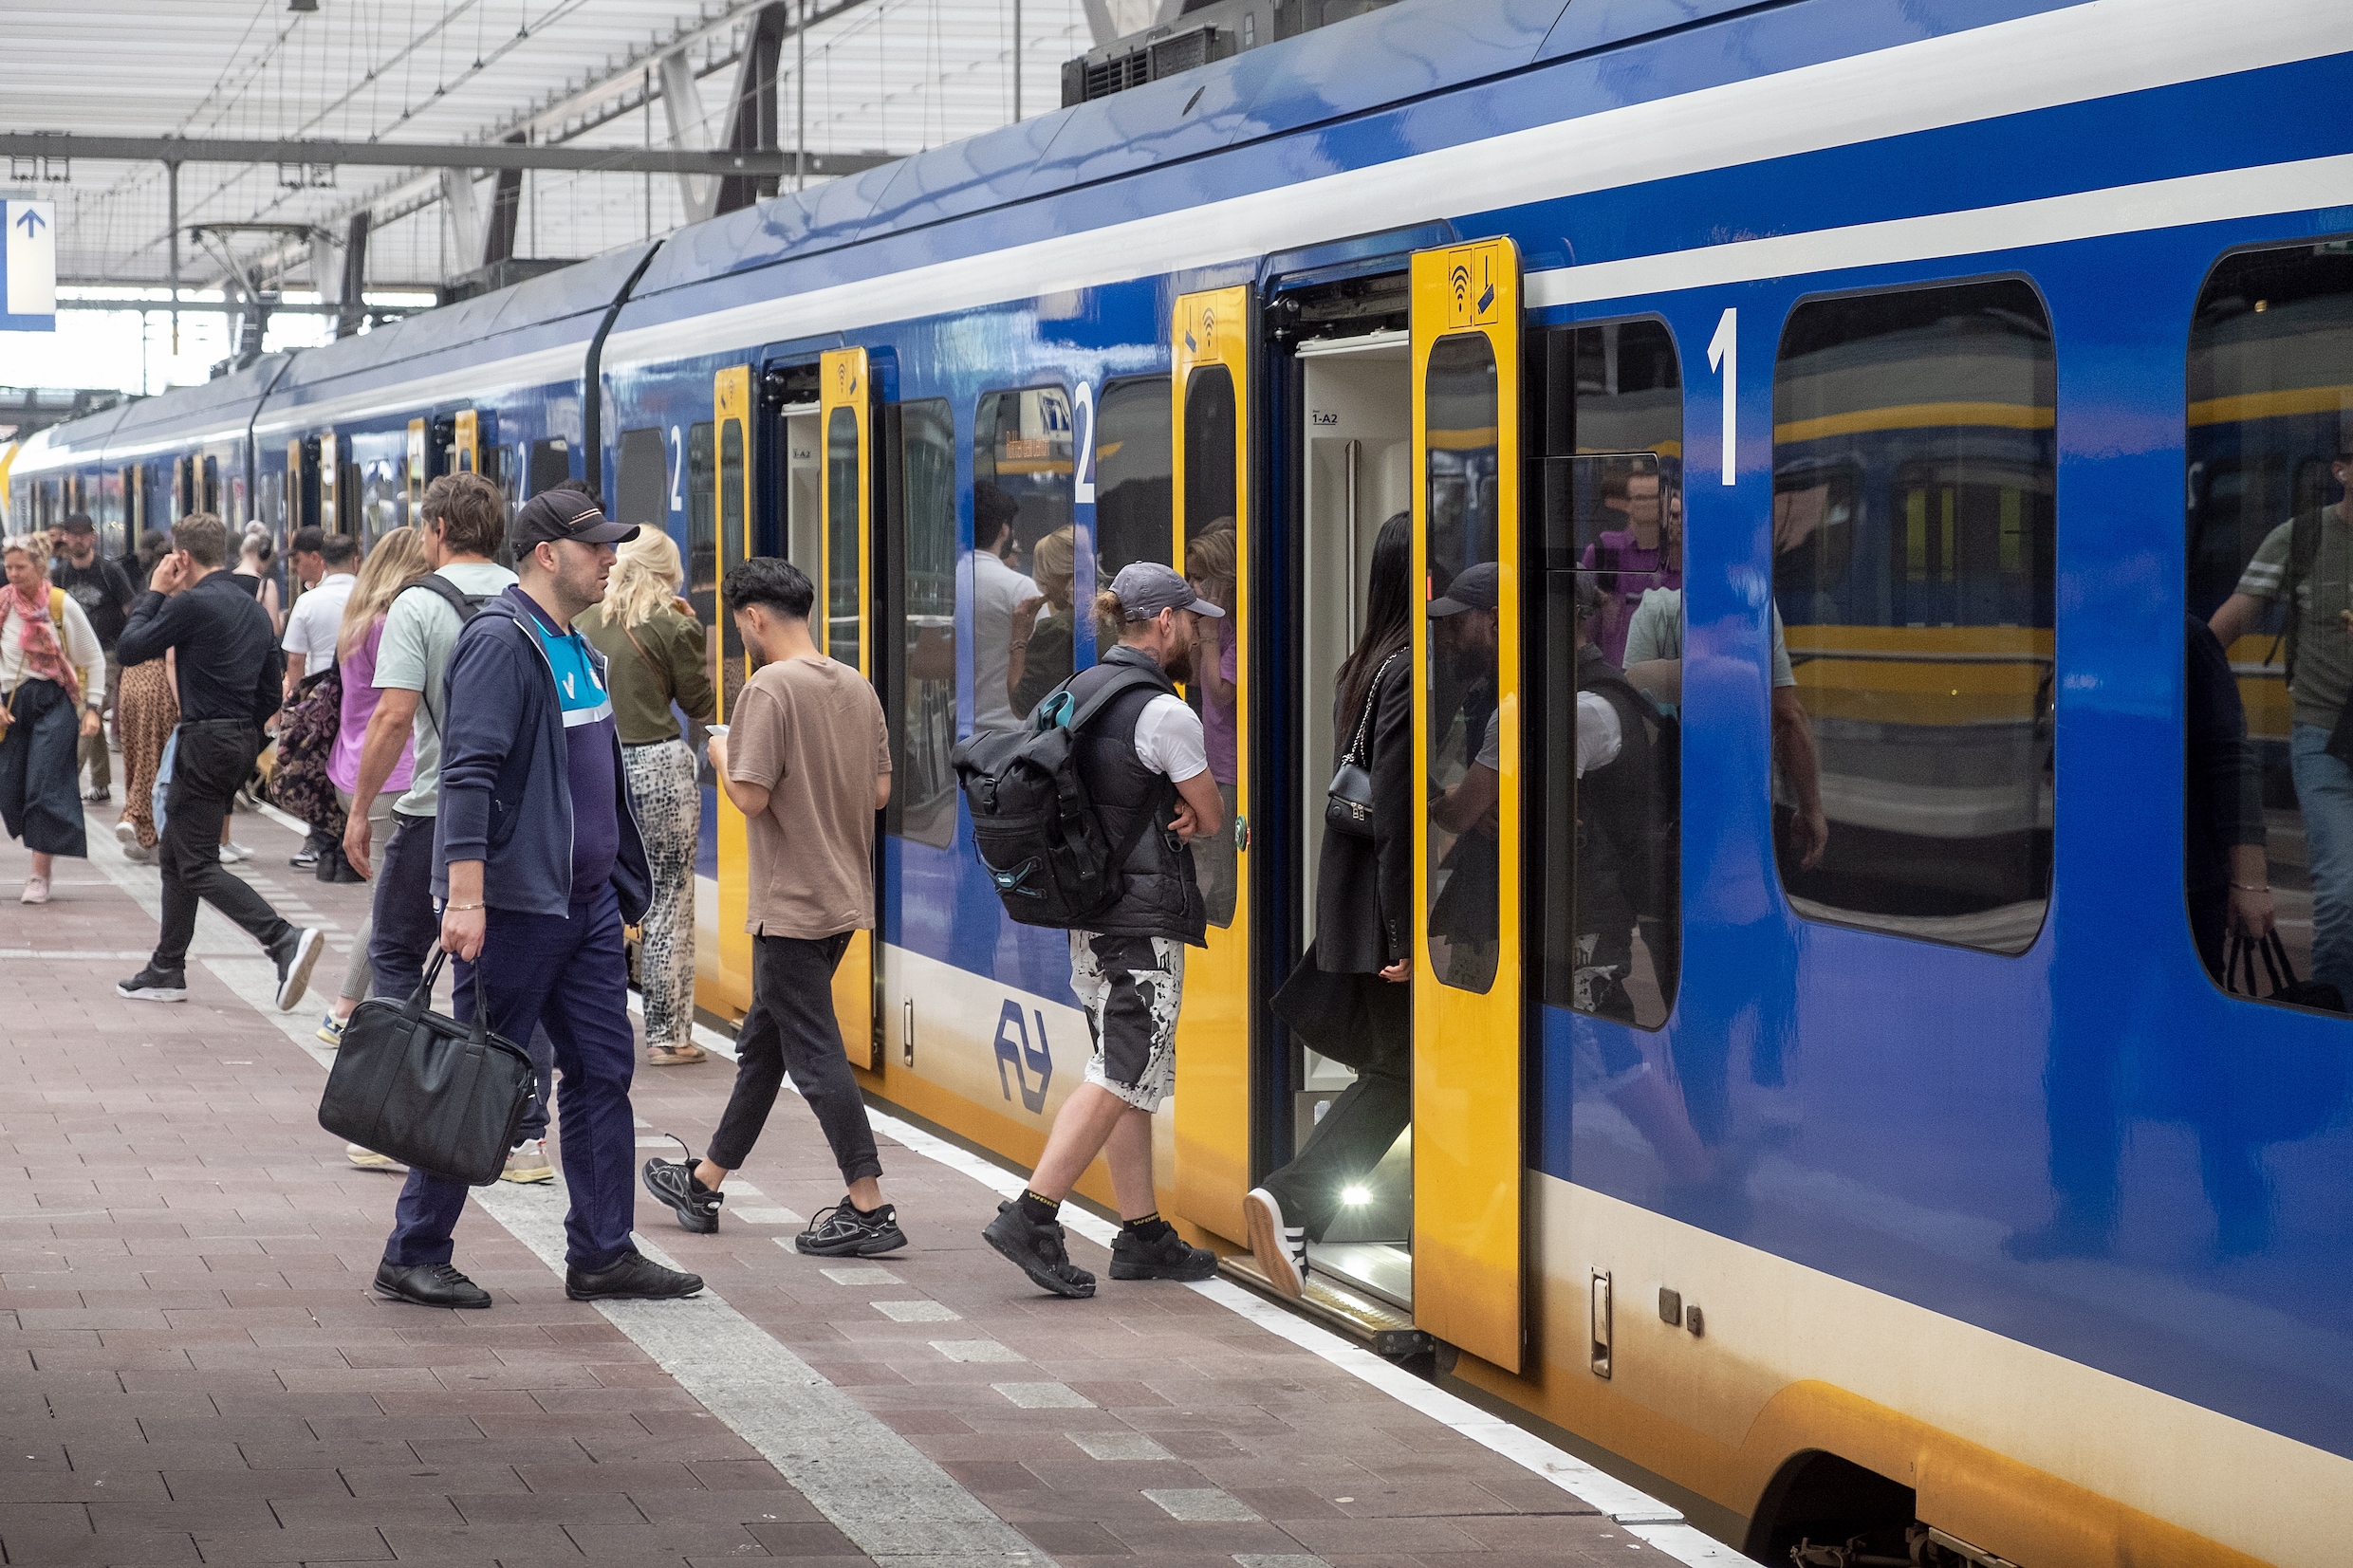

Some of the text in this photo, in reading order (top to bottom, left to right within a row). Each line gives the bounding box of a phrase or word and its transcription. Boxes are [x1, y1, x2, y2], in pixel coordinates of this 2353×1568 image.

[1312, 414, 1338, 423] 1-A2
[1707, 307, 1737, 486] 1
[517, 440, 528, 512] 2
[670, 424, 682, 511] 2
[1075, 380, 1095, 504] 2
